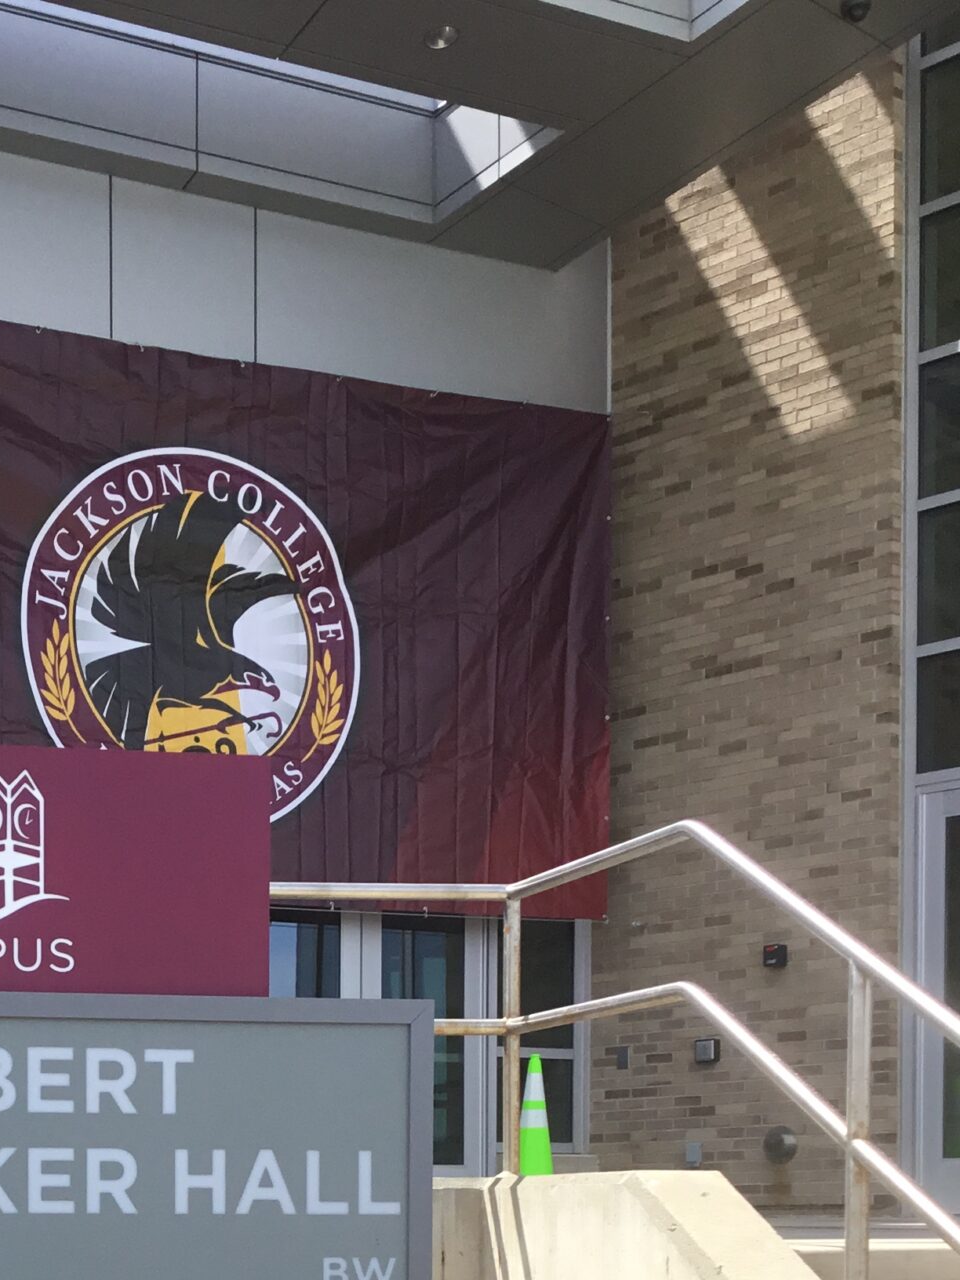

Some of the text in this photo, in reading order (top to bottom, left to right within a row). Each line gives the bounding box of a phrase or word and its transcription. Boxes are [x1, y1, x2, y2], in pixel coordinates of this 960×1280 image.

[35, 463, 345, 643] JACKSON COLLEGE
[269, 760, 303, 804] AS
[174, 1148, 401, 1215] HALL
